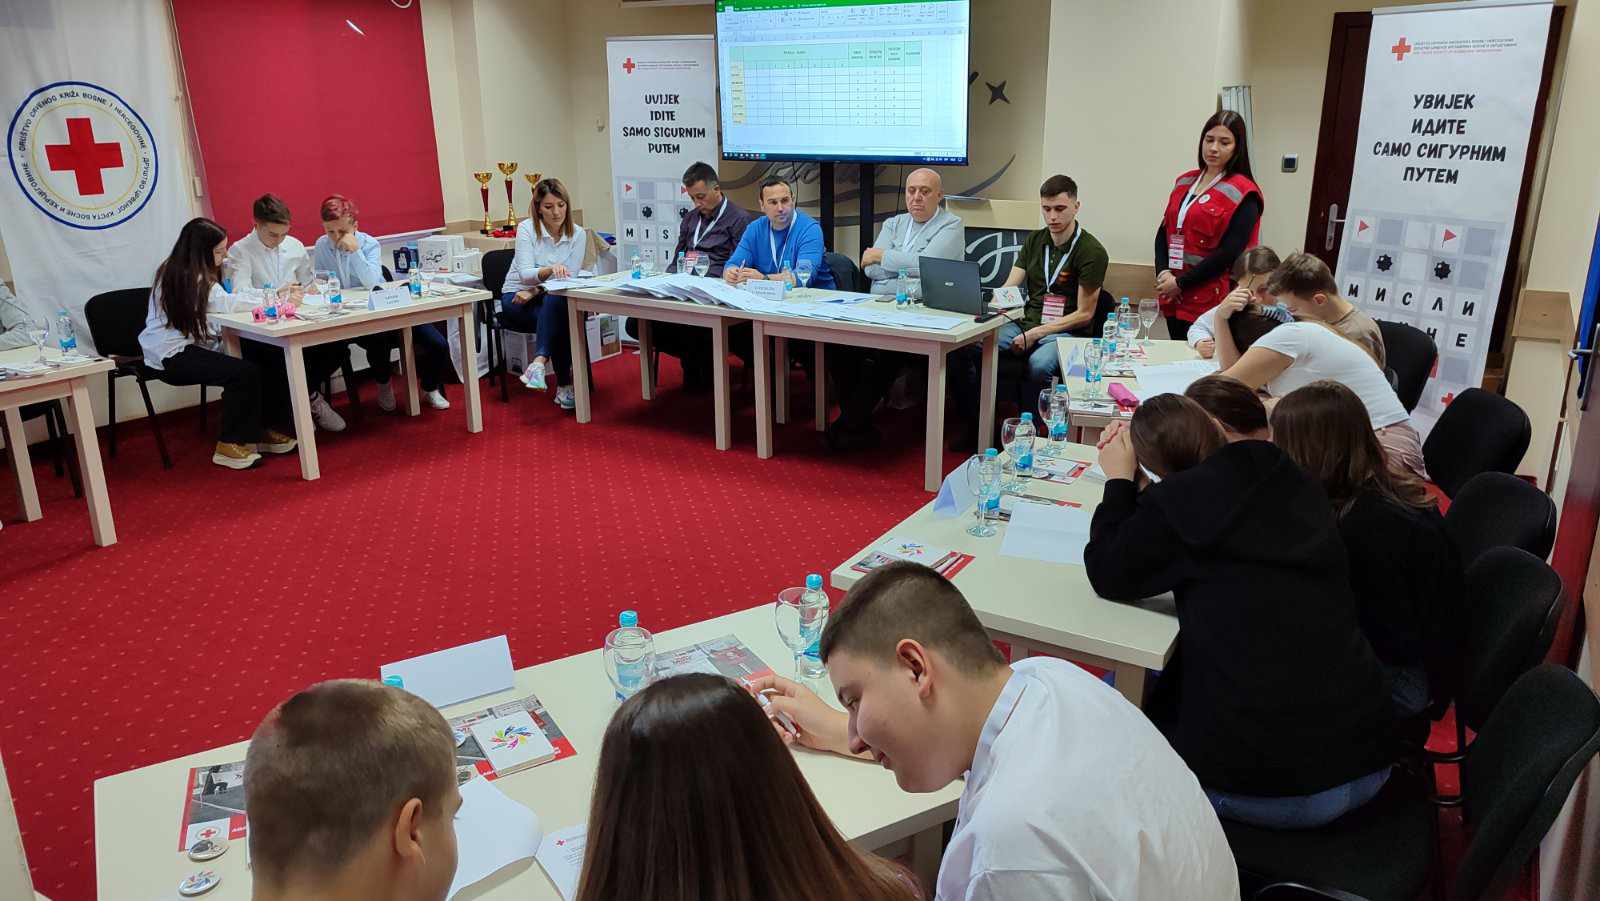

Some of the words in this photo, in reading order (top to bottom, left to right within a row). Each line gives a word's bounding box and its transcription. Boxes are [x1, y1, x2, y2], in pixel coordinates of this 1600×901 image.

[644, 94, 680, 105] UVIJEK
[1413, 94, 1476, 110] УВИЈЕК
[59, 90, 80, 99] KRIŽA
[82, 92, 107, 105] BOSNE
[114, 106, 147, 149] HERCEGOVINE
[650, 110, 676, 121] IDITE
[622, 126, 651, 137] SAMO
[654, 127, 706, 138] SIGURNIM
[1411, 118, 1467, 136] ИДИТЕ
[648, 143, 680, 154] PUTEM
[1373, 141, 1412, 157] САМО
[1416, 143, 1506, 162] СИГУРНИМ
[1403, 166, 1459, 184] ПУТЕМ
